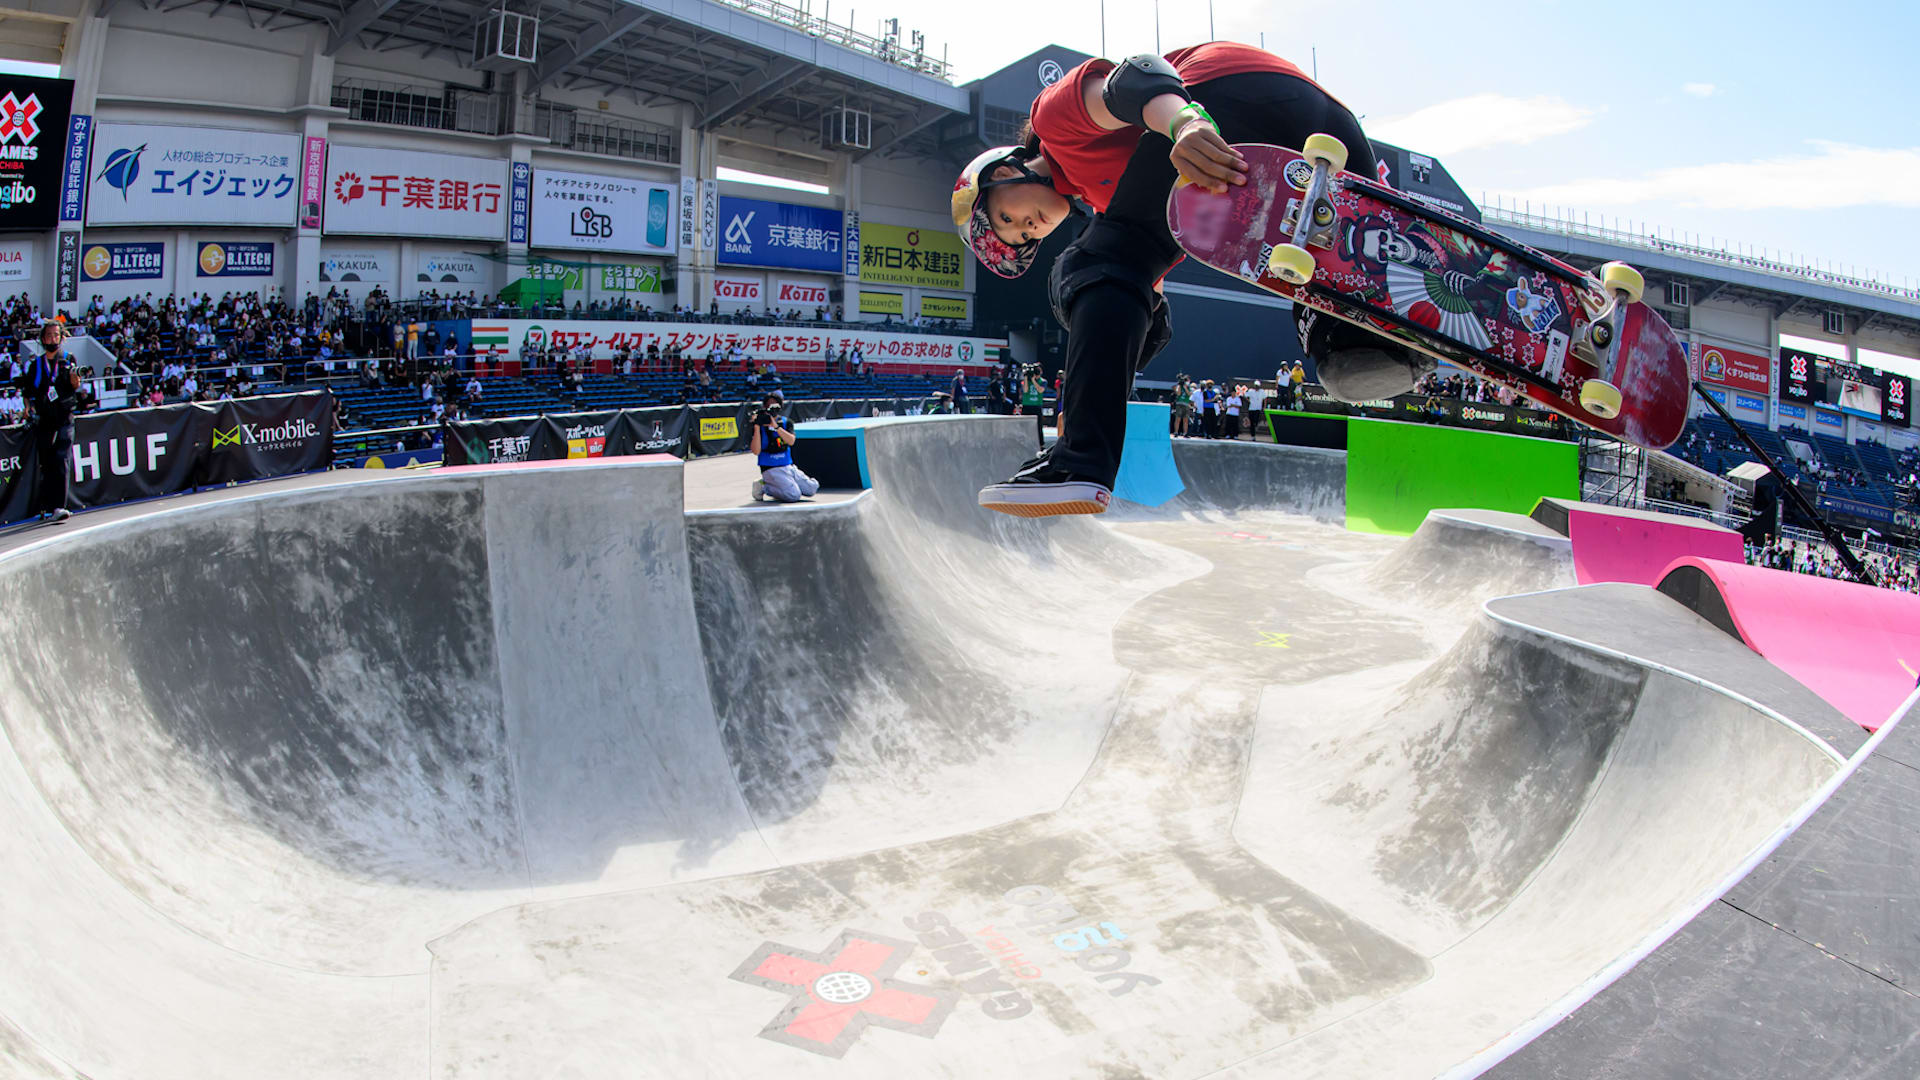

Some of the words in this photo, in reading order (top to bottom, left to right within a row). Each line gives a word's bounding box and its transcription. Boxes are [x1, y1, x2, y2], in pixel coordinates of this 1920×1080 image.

[66, 117, 87, 218] みずほ信託銀行
[162, 150, 289, 167] 人材の総合プロデュース企業
[307, 140, 322, 201] 新京成電鉄
[0, 181, 36, 206] gibo
[151, 169, 294, 199] エイジェック
[367, 175, 501, 214] 千葉銀行
[545, 178, 638, 194] アイデアとテクノロジーで
[725, 242, 752, 254] BANK
[768, 224, 840, 253] 京葉銀行
[113, 253, 161, 268] B.I.TECH
[227, 252, 271, 266] B.I.TECH
[337, 261, 378, 270] KAKUTA
[438, 263, 475, 272] KAKUTA
[863, 244, 960, 276] 新日本建設
[863, 272, 914, 283] INTELLIGENT
[917, 277, 960, 287] DEVELOPER
[1476, 410, 1505, 422] GAMES
[241, 418, 316, 445] X-mobile
[565, 424, 605, 440] スポーツくじ
[72, 432, 169, 483] HUF
[488, 435, 531, 457] 千葉市
[976, 924, 1043, 980] CHIBA
[903, 910, 1034, 1021] GAMES
